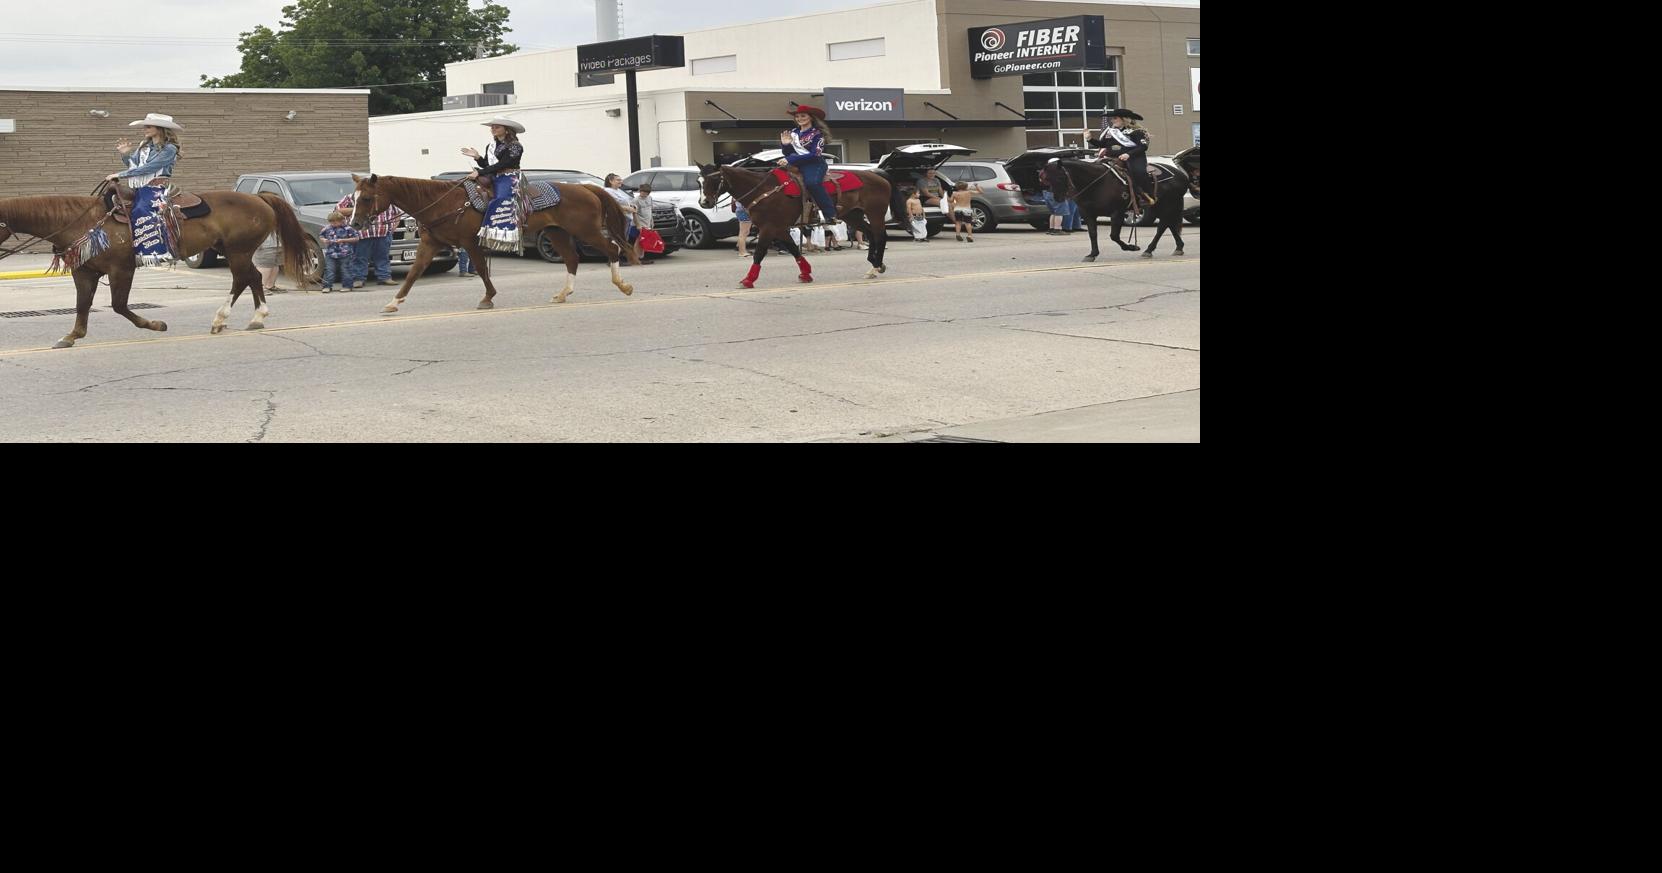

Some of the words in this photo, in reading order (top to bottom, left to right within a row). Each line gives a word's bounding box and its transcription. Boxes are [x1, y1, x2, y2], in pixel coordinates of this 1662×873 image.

[1016, 25, 1080, 47] FIBER
[974, 51, 1015, 62] Pioneer
[1016, 42, 1077, 58] INTERNET
[607, 54, 652, 68] Packages
[994, 61, 1061, 73] GoPioneer.com
[835, 98, 893, 111] verizon
